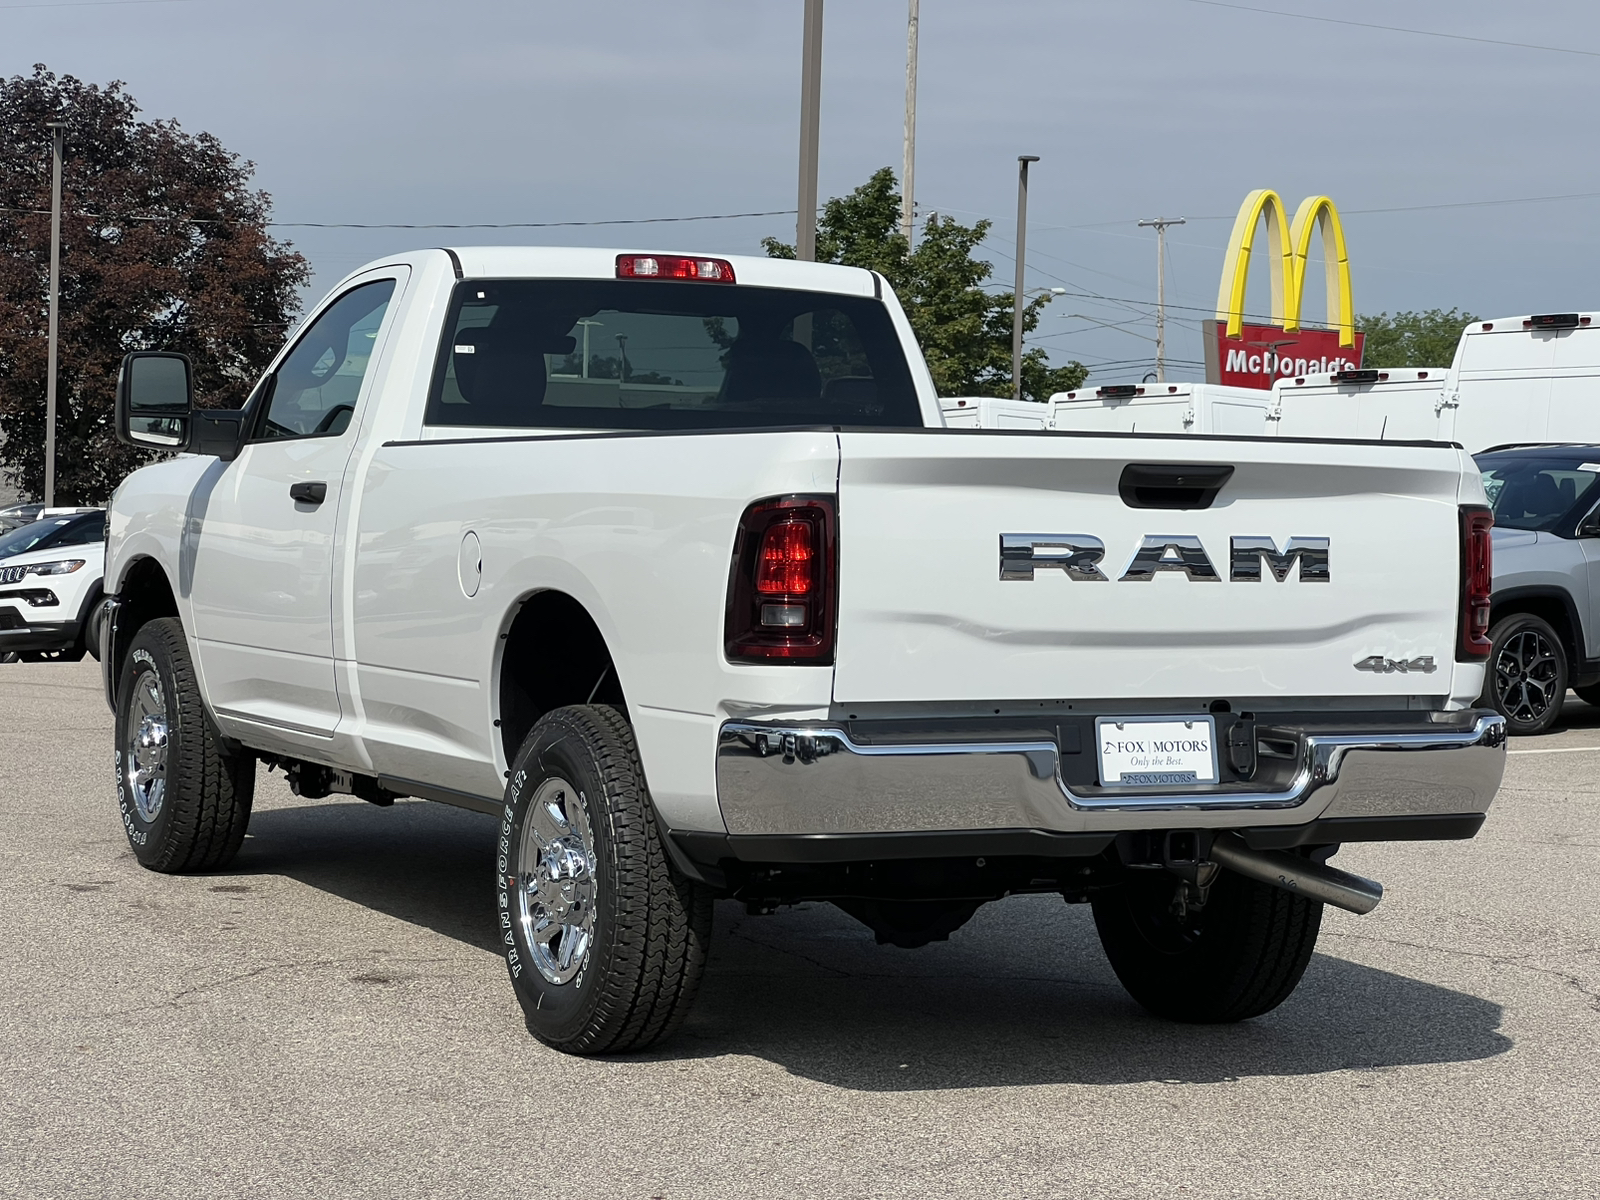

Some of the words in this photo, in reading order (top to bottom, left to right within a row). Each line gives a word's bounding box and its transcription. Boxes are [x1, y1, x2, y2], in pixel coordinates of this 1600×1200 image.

[999, 533, 1331, 583] RAM
[1353, 654, 1438, 674] 4x4
[1117, 741, 1145, 753] FOX
[1153, 740, 1208, 753] MOTORS
[1130, 756, 1150, 769] Only
[1152, 756, 1164, 766] the
[1165, 755, 1183, 766] Best.
[499, 804, 522, 979] TRANSFORCE
